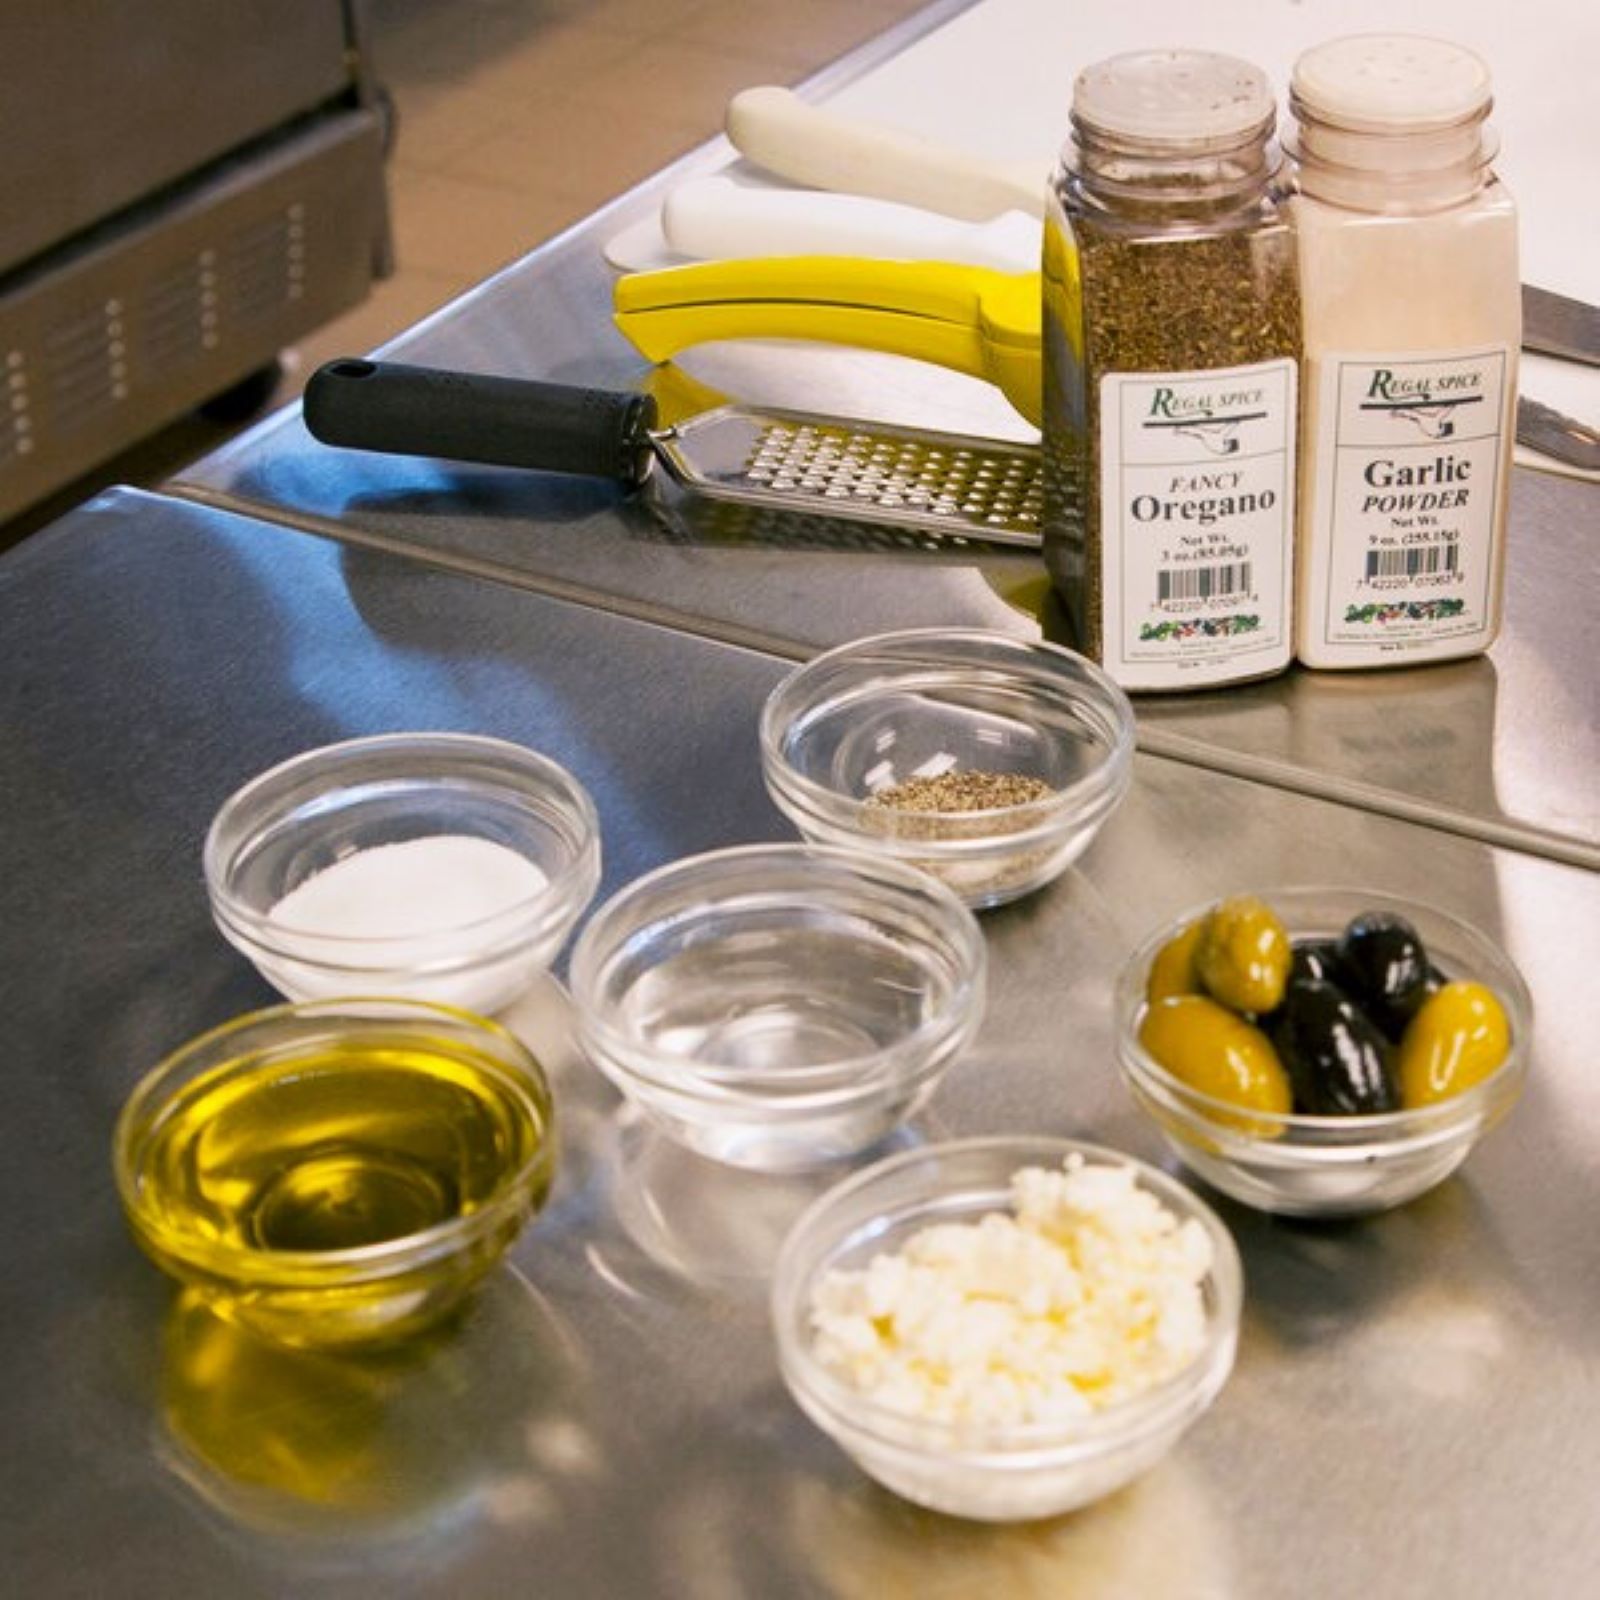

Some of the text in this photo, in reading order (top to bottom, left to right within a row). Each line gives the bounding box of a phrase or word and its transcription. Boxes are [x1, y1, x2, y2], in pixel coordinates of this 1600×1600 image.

[1367, 369, 1482, 401] REGAL SPICE
[1150, 387, 1263, 418] REGAL SPICE
[1169, 471, 1243, 493] FANCY
[1364, 455, 1471, 488] Garlic
[1131, 489, 1276, 525] Oregano
[1361, 488, 1470, 513] POWDER
[1391, 516, 1438, 528] Net Wt.
[1180, 534, 1228, 546] Net Wt.
[1369, 529, 1460, 546] 9 oz. (255.15g)
[1160, 550, 1170, 561] 3
